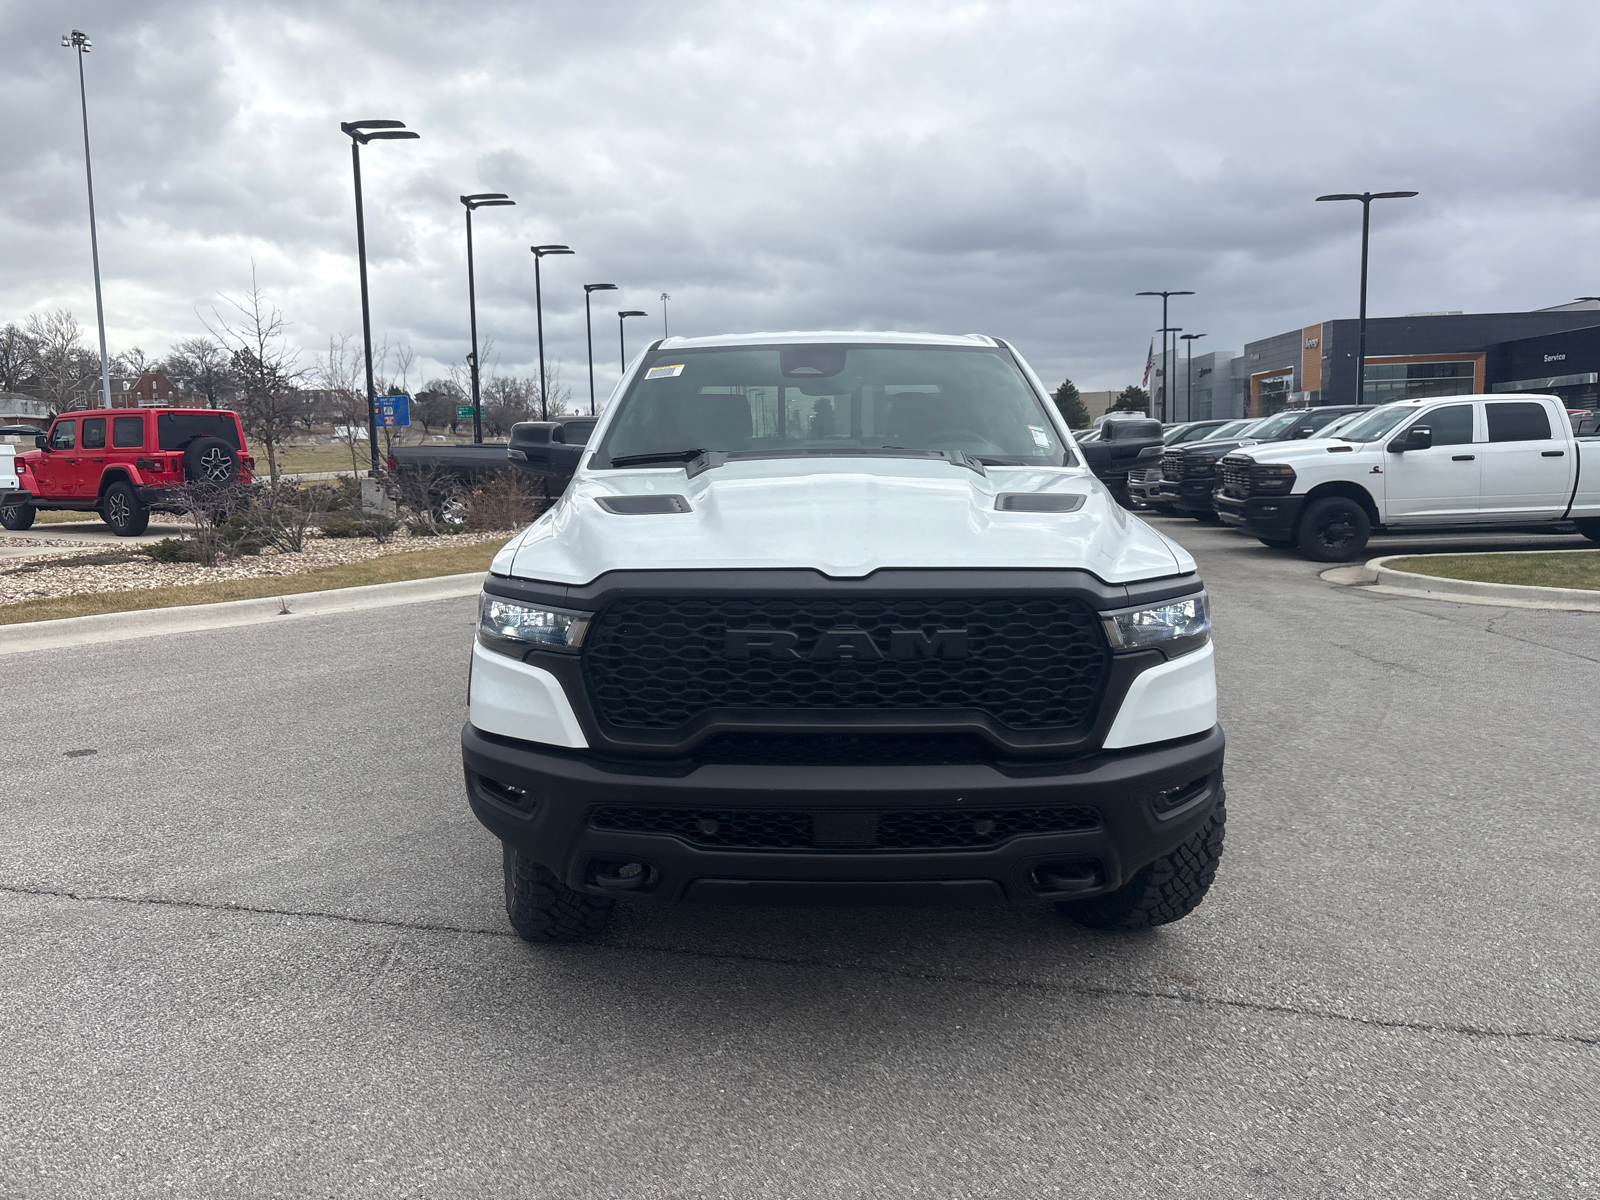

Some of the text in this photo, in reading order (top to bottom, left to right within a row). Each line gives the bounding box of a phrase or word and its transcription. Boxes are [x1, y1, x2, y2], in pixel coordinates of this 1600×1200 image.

[1305, 338, 1319, 349] Jeep
[1543, 352, 1566, 363] Service
[724, 628, 969, 659] RAM
